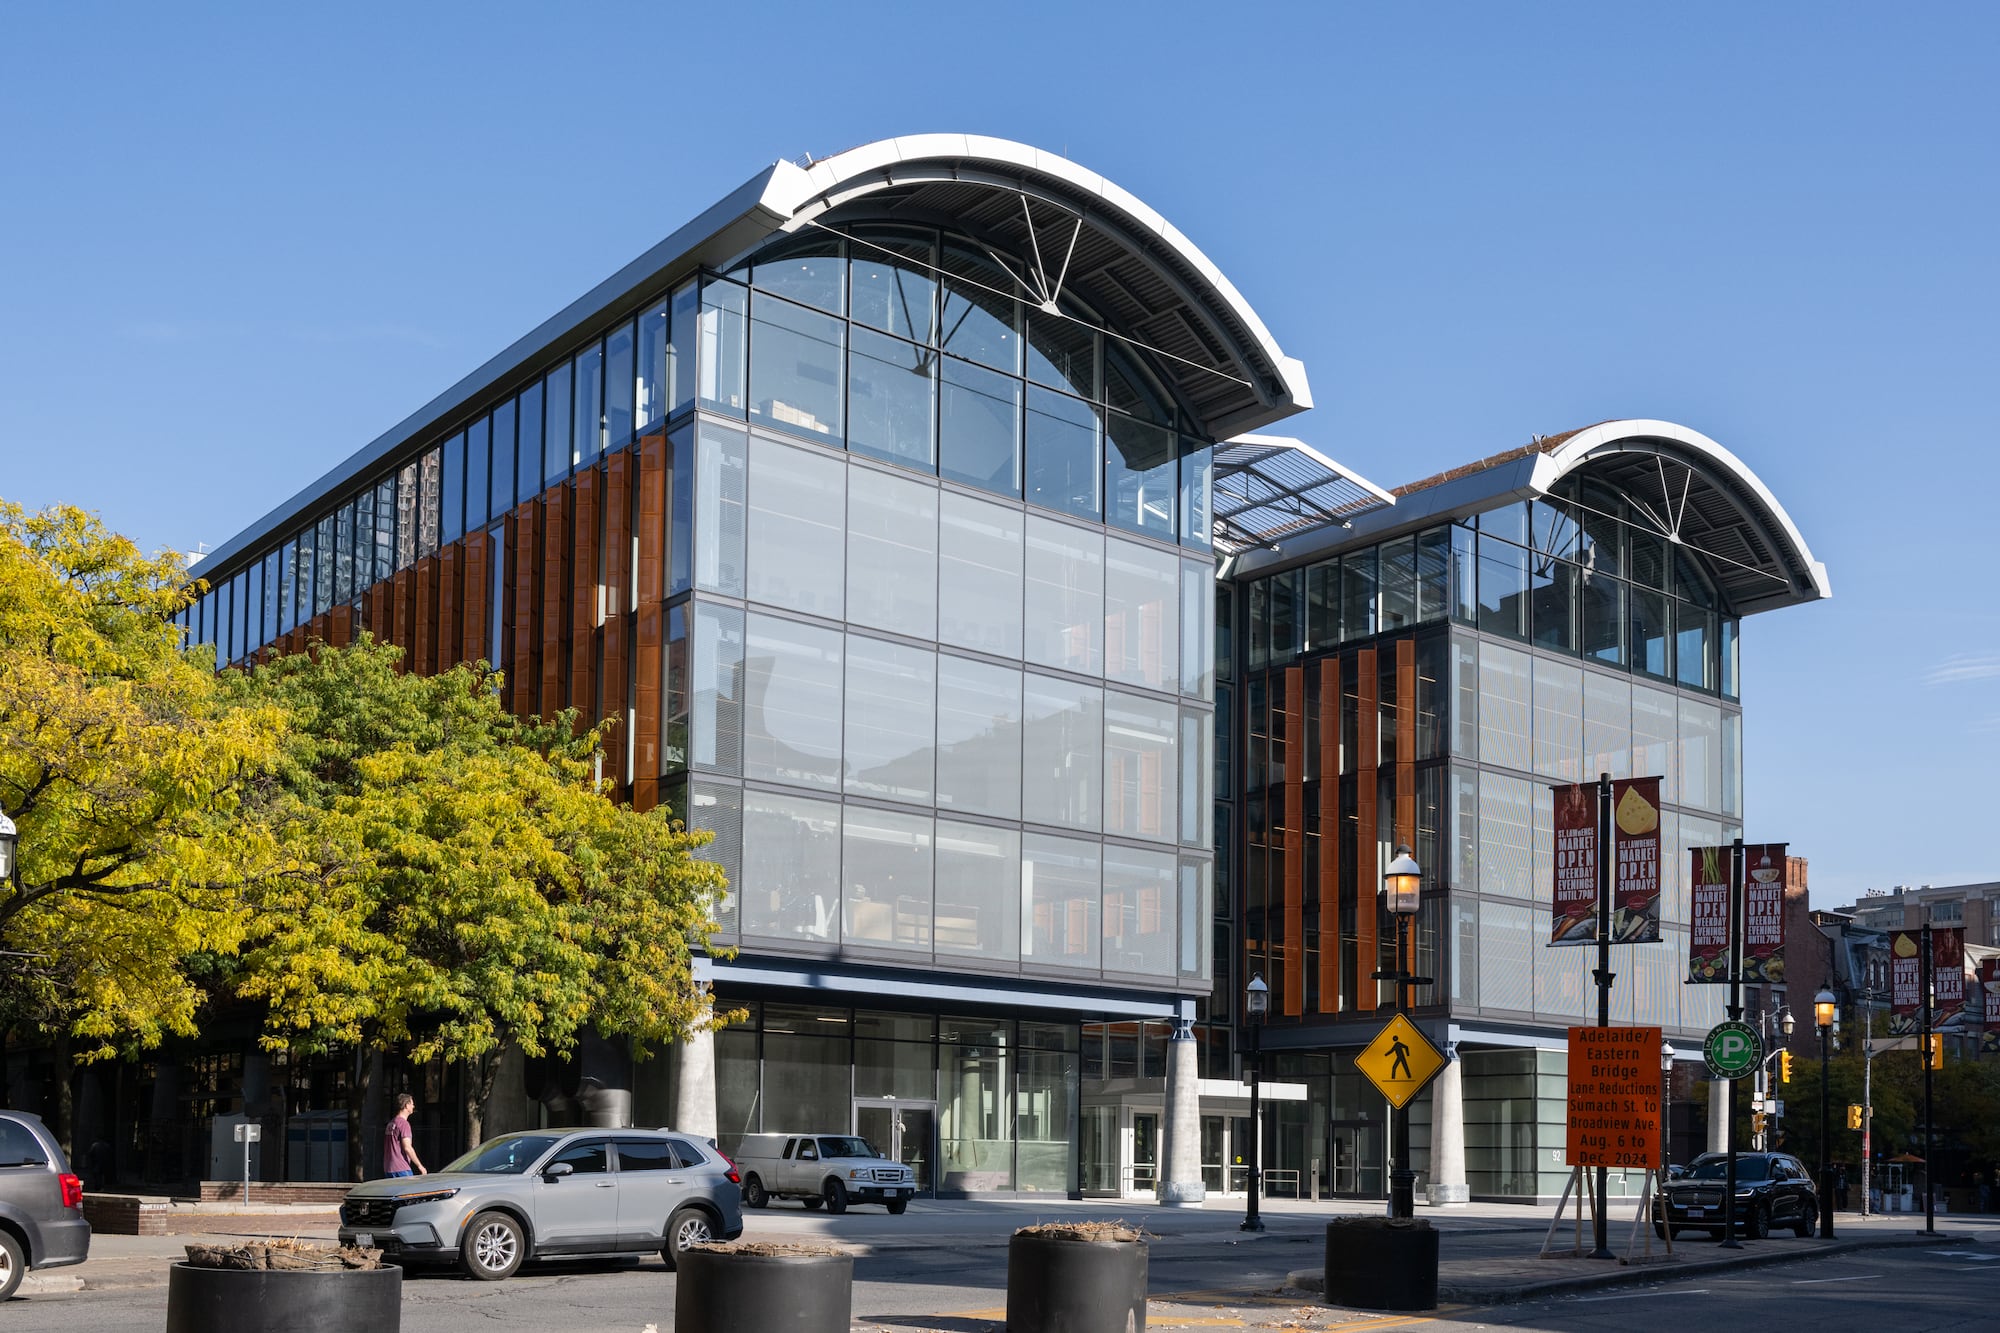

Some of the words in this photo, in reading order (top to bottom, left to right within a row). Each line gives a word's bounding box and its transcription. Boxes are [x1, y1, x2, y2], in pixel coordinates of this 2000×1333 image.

[1558, 836, 1594, 851] MARKET
[1628, 839, 1656, 848] LAWRENCE
[1558, 850, 1594, 868] OPEN
[1620, 848, 1656, 862] MARKET
[1558, 866, 1594, 879] WEEKDAY
[1620, 861, 1656, 880] OPEN
[1558, 878, 1594, 890] EVENINGS
[1620, 878, 1656, 891] SUNDAYS
[1558, 890, 1578, 901] UNTIL
[1578, 889, 1594, 900] 7PM
[1696, 892, 1726, 902] MARKET
[1749, 890, 1781, 901] MARKET
[1696, 902, 1726, 917] OPEN
[1749, 900, 1781, 915] OPEN
[1695, 917, 1726, 927] WEEKDAY
[1749, 915, 1781, 925] WEEKDAY
[1695, 926, 1726, 936] EVENINGS
[1748, 925, 1781, 935] EVENINGS
[1694, 936, 1711, 945] UNTIL
[1712, 936, 1726, 944] 7PM
[1748, 935, 1765, 944] UNTIL
[1766, 934, 1780, 944] 7PM
[1894, 964, 1919, 972] MARKET
[1894, 972, 1919, 984] OPEN
[1937, 981, 1962, 992] OPEN
[1580, 1030, 1650, 1043] Adelaide/
[1706, 1024, 1758, 1048] MUNICIPAL
[1722, 1036, 1744, 1058] P
[1587, 1048, 1639, 1060] Eastern
[1706, 1054, 1758, 1076] PARKING
[1592, 1065, 1638, 1080] Bridge
[1571, 1082, 1594, 1094] Lane
[1600, 1082, 1657, 1095] Reductions
[1570, 1100, 1618, 1112] Sumach
[1624, 1100, 1639, 1112] St.
[1645, 1102, 1656, 1112] to
[1571, 1117, 1629, 1130] Broadview
[1635, 1118, 1658, 1131] Ave.
[1580, 1134, 1610, 1149] Aug.
[1618, 1135, 1625, 1147] 6
[1632, 1136, 1645, 1148] to
[1552, 1150, 1560, 1161] 92
[1580, 1152, 1608, 1164] Dec.
[1616, 1152, 1647, 1165] 2024
